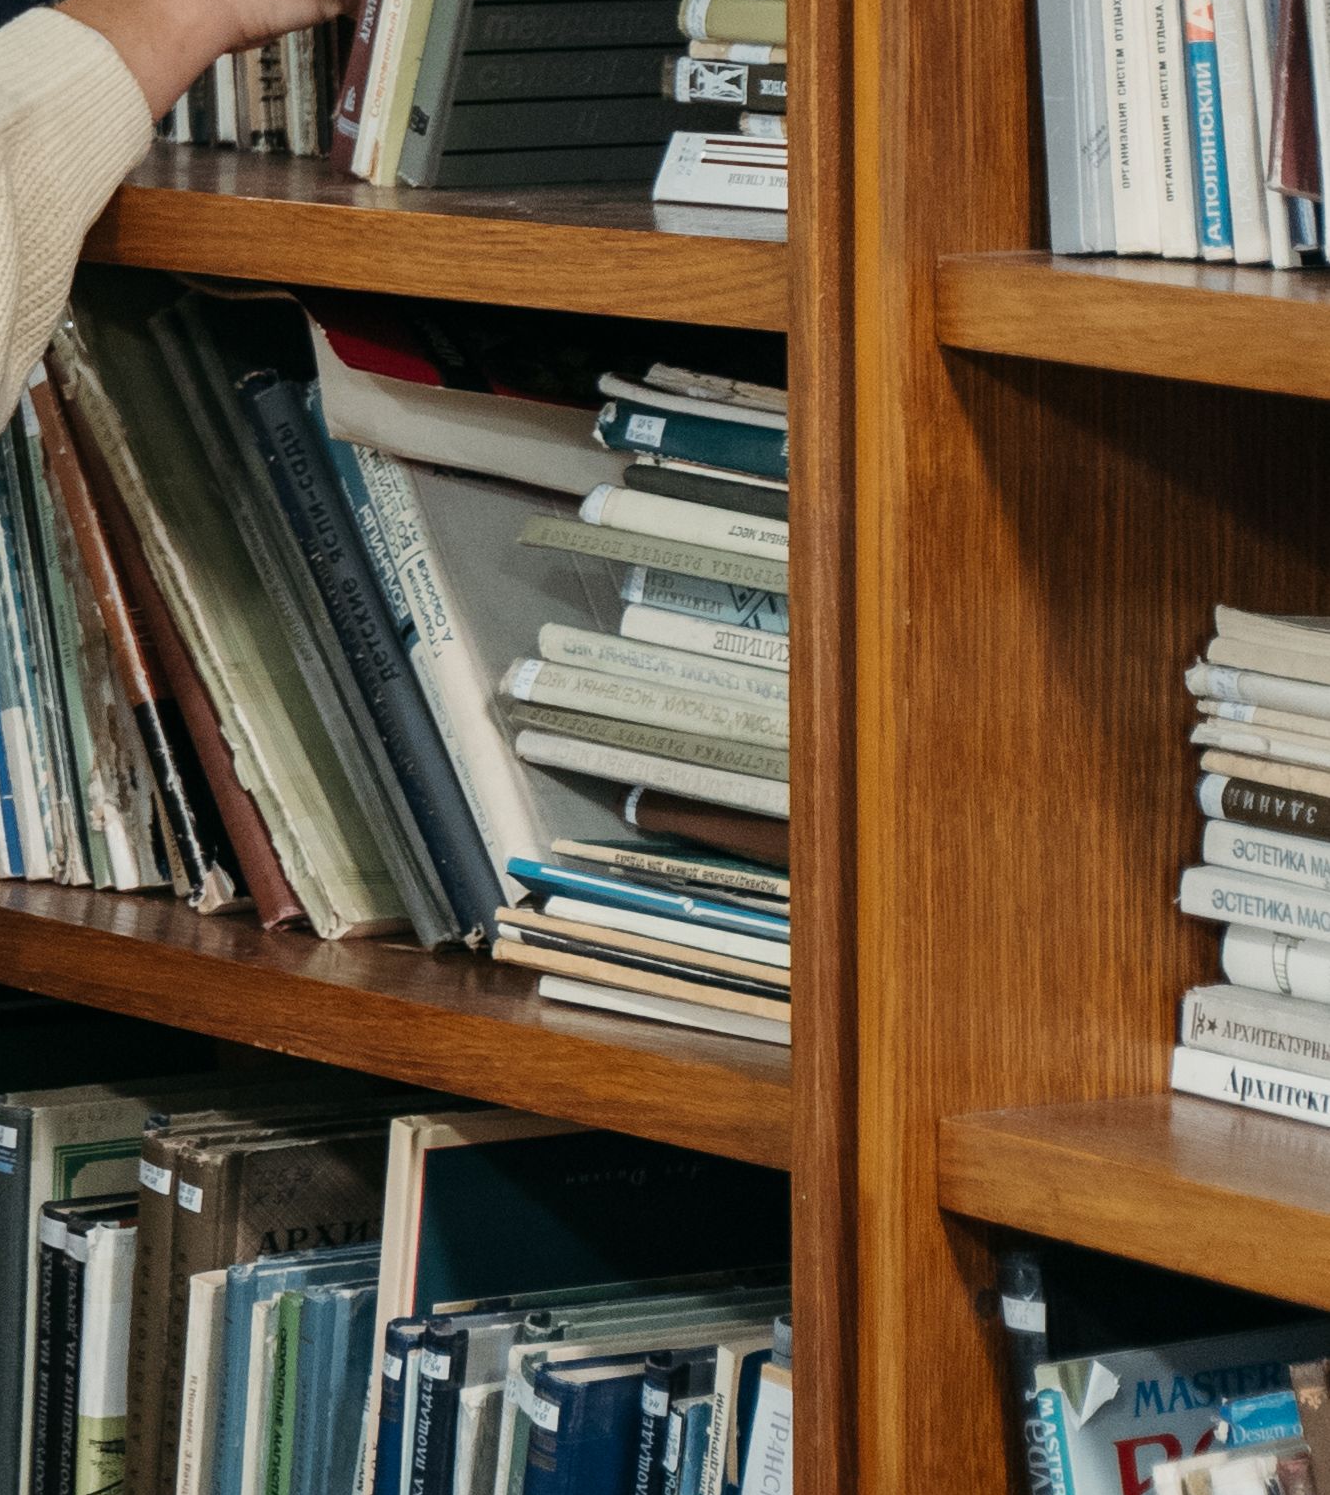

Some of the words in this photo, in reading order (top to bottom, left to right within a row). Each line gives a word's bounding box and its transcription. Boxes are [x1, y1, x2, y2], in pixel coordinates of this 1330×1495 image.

[370, 9, 399, 119] Современный
[1115, 51, 1127, 106] СИСТЕМ
[1159, 54, 1170, 108] СИСТЕМ
[1114, 113, 1130, 191] ОРГАНИЗАЦИЯ
[1158, 114, 1175, 203] ОРГАНИЗАЦИЯ
[1194, 59, 1225, 243] А.ПОЛЯНСКИЙ
[360, 503, 411, 620] БОЛЬНИЦЫ
[572, 676, 657, 711] НАСЕЛЕННЫХ
[661, 696, 731, 727] СЕЛЬСКИХ
[616, 728, 688, 757] РАБОЧИХ
[694, 741, 785, 775] ЗАСТРОЙКА
[1232, 838, 1308, 872] ЭСТЕТИКА
[1211, 889, 1296, 924] ЭСТЕТИКА
[64, 1343, 78, 1369] НА
[274, 1325, 289, 1431] СКОРОСТНЫЕ
[1227, 1423, 1285, 1445] Design
